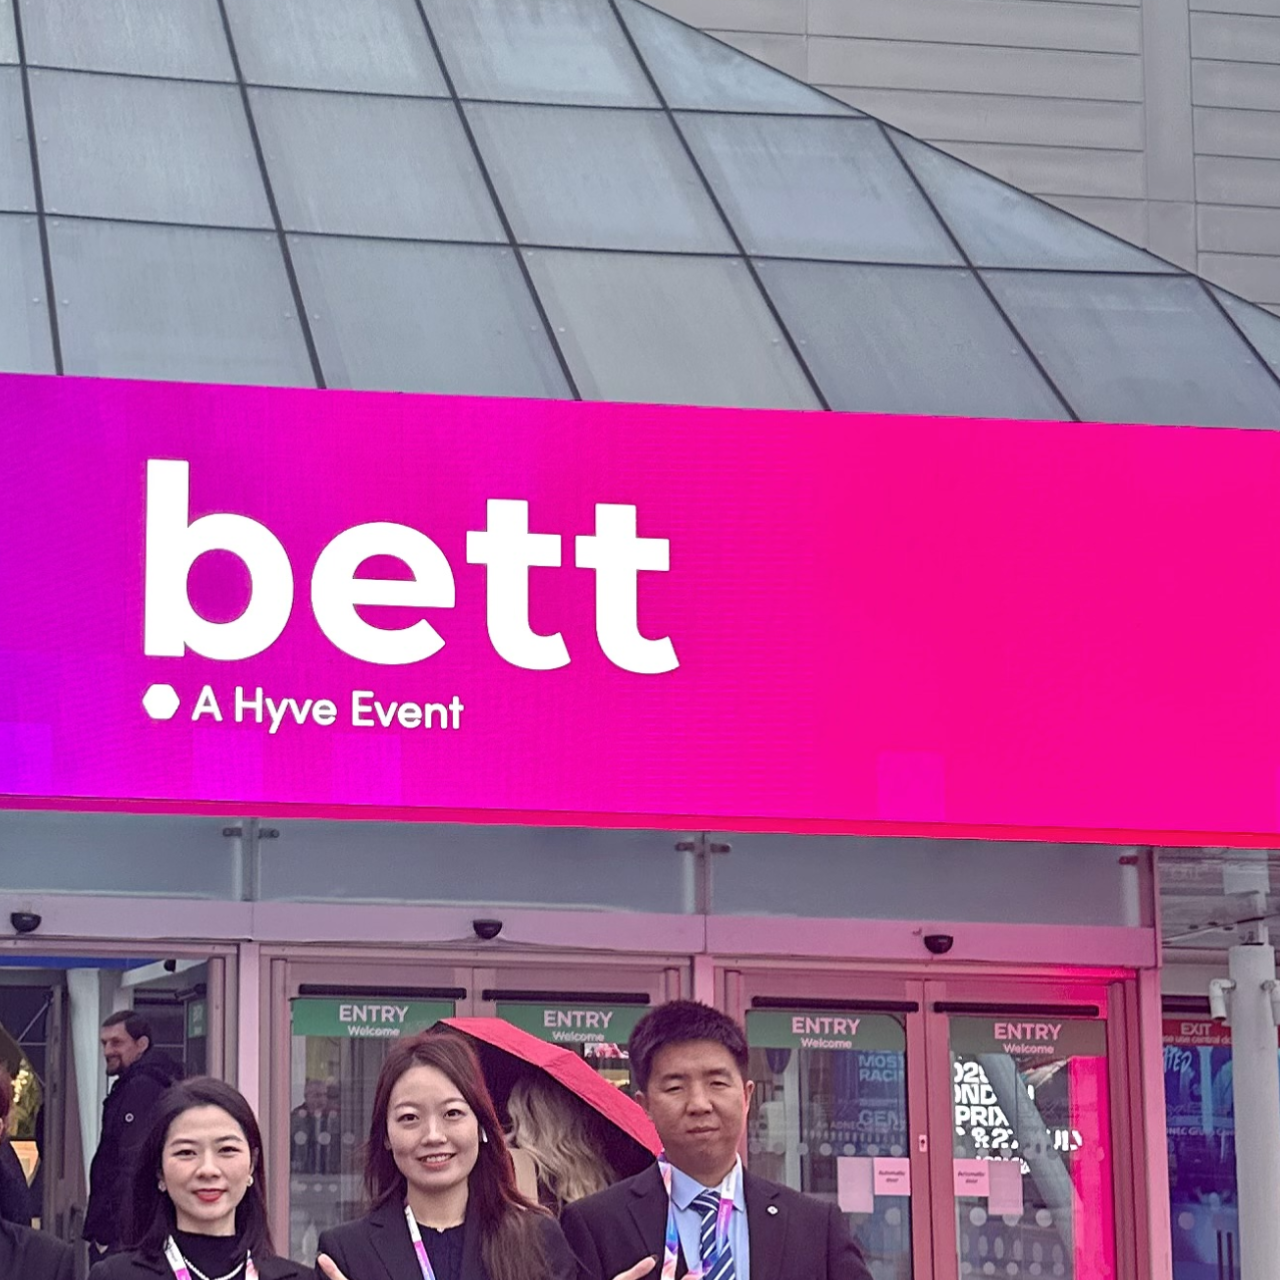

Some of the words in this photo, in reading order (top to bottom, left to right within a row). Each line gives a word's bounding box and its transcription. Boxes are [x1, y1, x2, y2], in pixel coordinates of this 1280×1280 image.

[144, 458, 680, 674] bett
[191, 684, 222, 721] A
[234, 686, 337, 734] Hyve
[351, 690, 464, 729] Event
[339, 1005, 409, 1023] ENTRY
[543, 1010, 613, 1029] ENTRY
[347, 1025, 400, 1037] Welcome
[792, 1017, 860, 1035] ENTRY
[994, 1023, 1062, 1041] ENTRY
[1181, 1022, 1212, 1035] EXIT
[552, 1031, 605, 1042] Welcome
[800, 1037, 852, 1049] Welcome
[1003, 1043, 1054, 1055] Welcome
